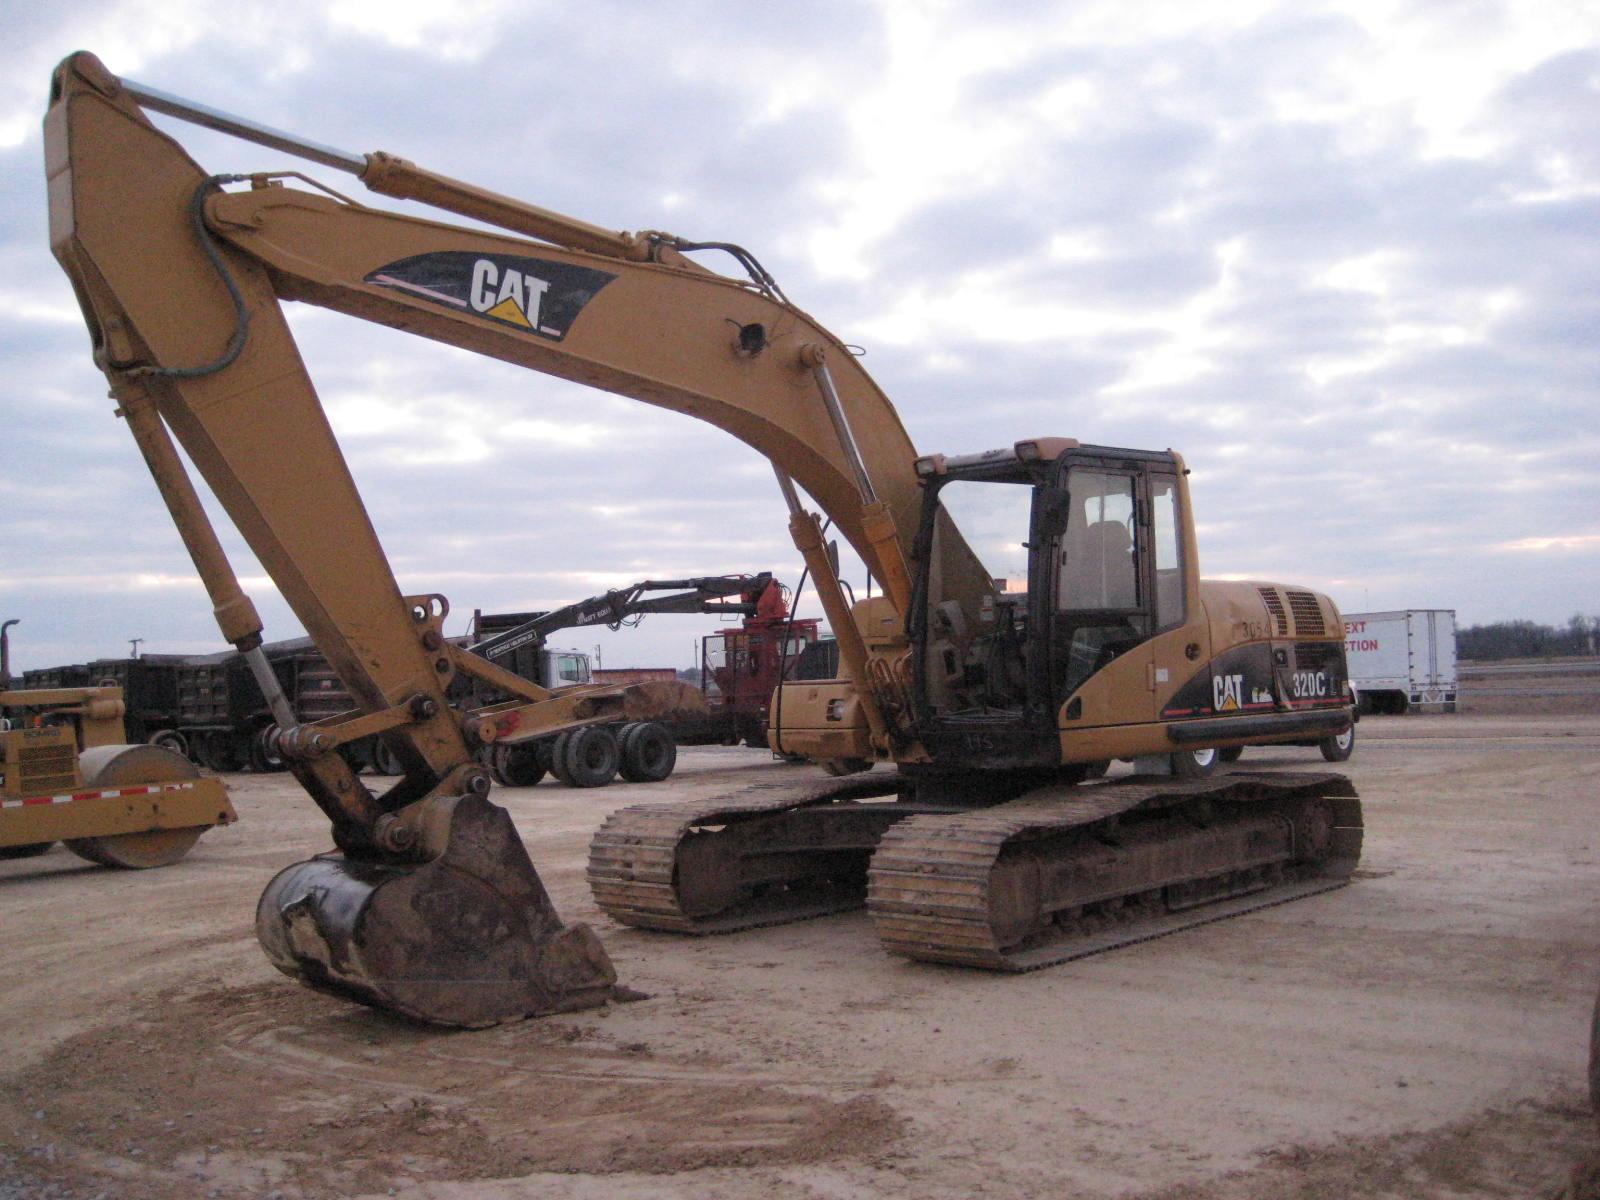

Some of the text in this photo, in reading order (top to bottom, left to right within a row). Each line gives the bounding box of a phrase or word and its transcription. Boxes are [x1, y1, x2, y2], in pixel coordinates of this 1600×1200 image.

[470, 259, 549, 330] CAT
[1213, 674, 1243, 711] CAT
[1293, 671, 1326, 698] 320C
